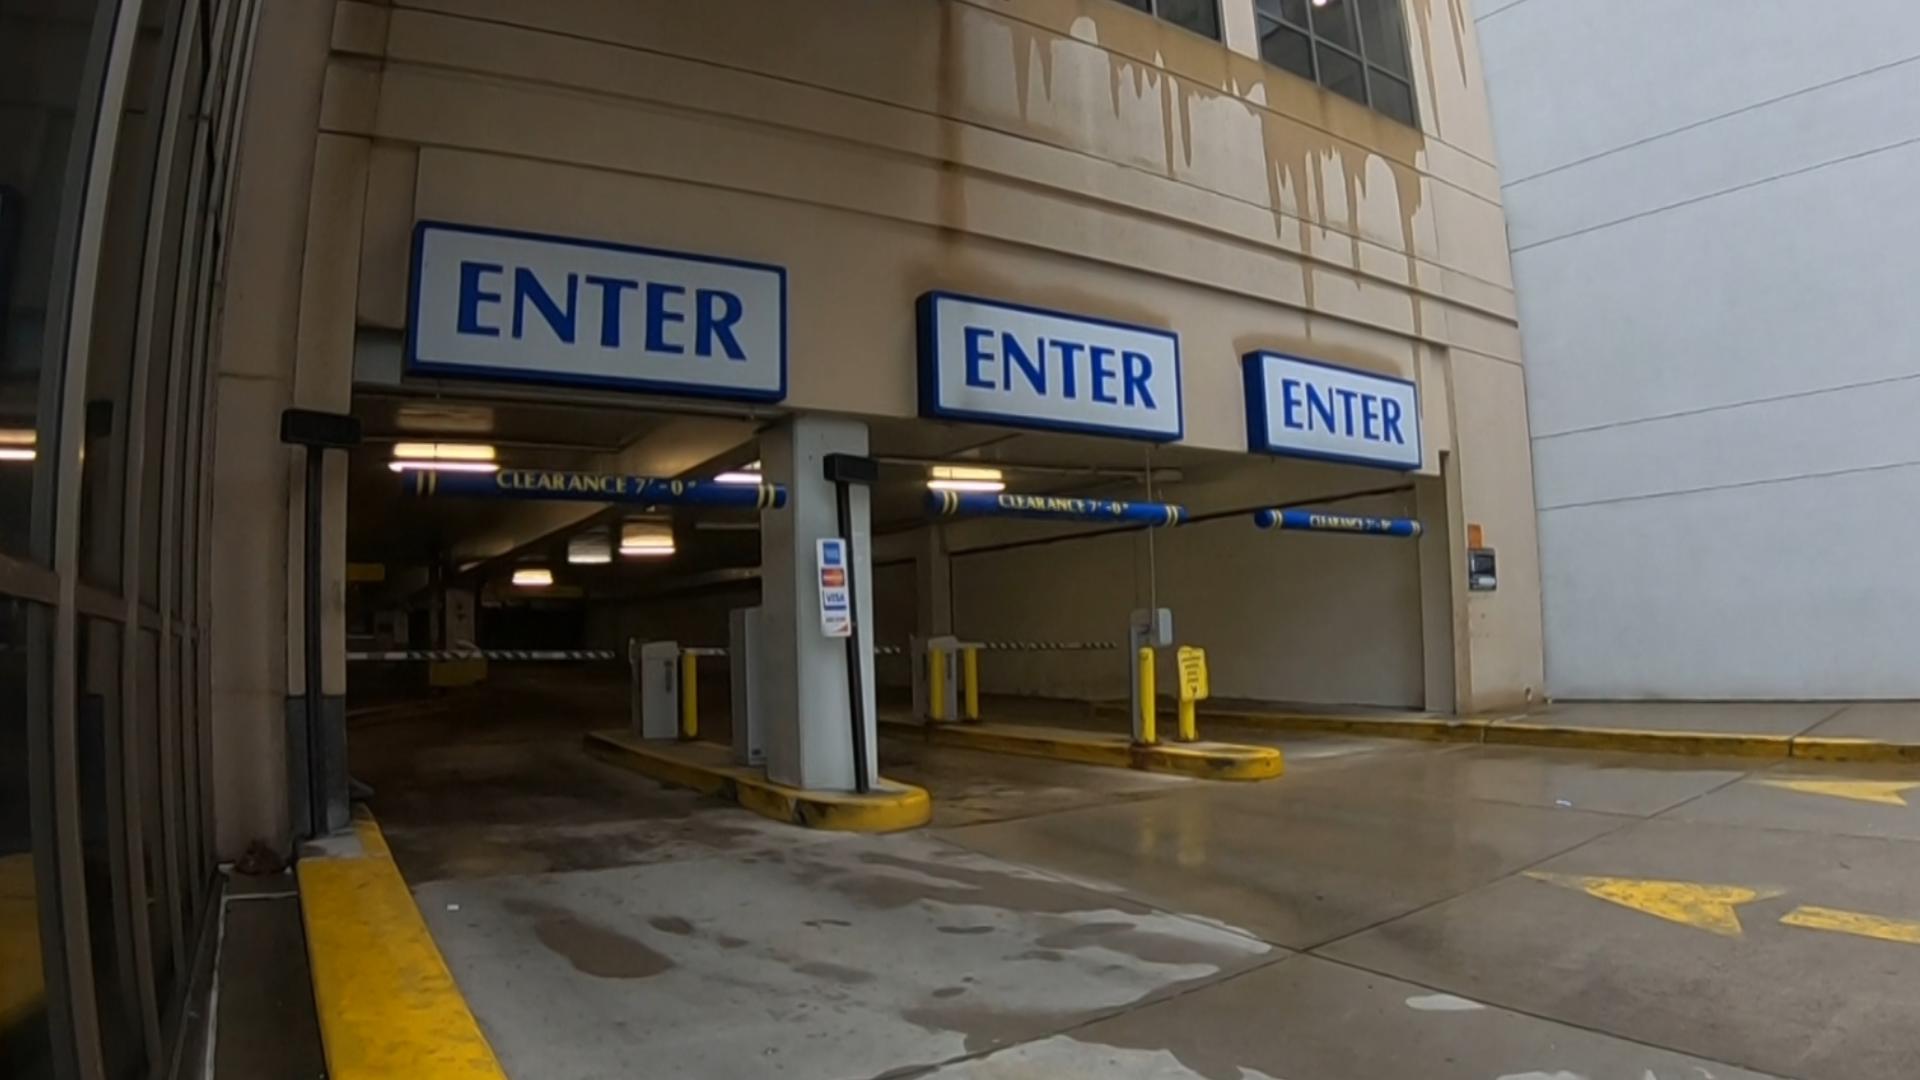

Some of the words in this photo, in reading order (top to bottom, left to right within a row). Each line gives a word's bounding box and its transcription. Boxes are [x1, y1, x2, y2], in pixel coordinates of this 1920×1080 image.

[457, 261, 746, 361] ENTER
[963, 326, 1157, 410] ENTER
[1281, 377, 1405, 445] ENTER
[496, 469, 626, 493] CLEARANCE
[998, 494, 1085, 513] CLEARANCE
[826, 592, 845, 602] VISA
